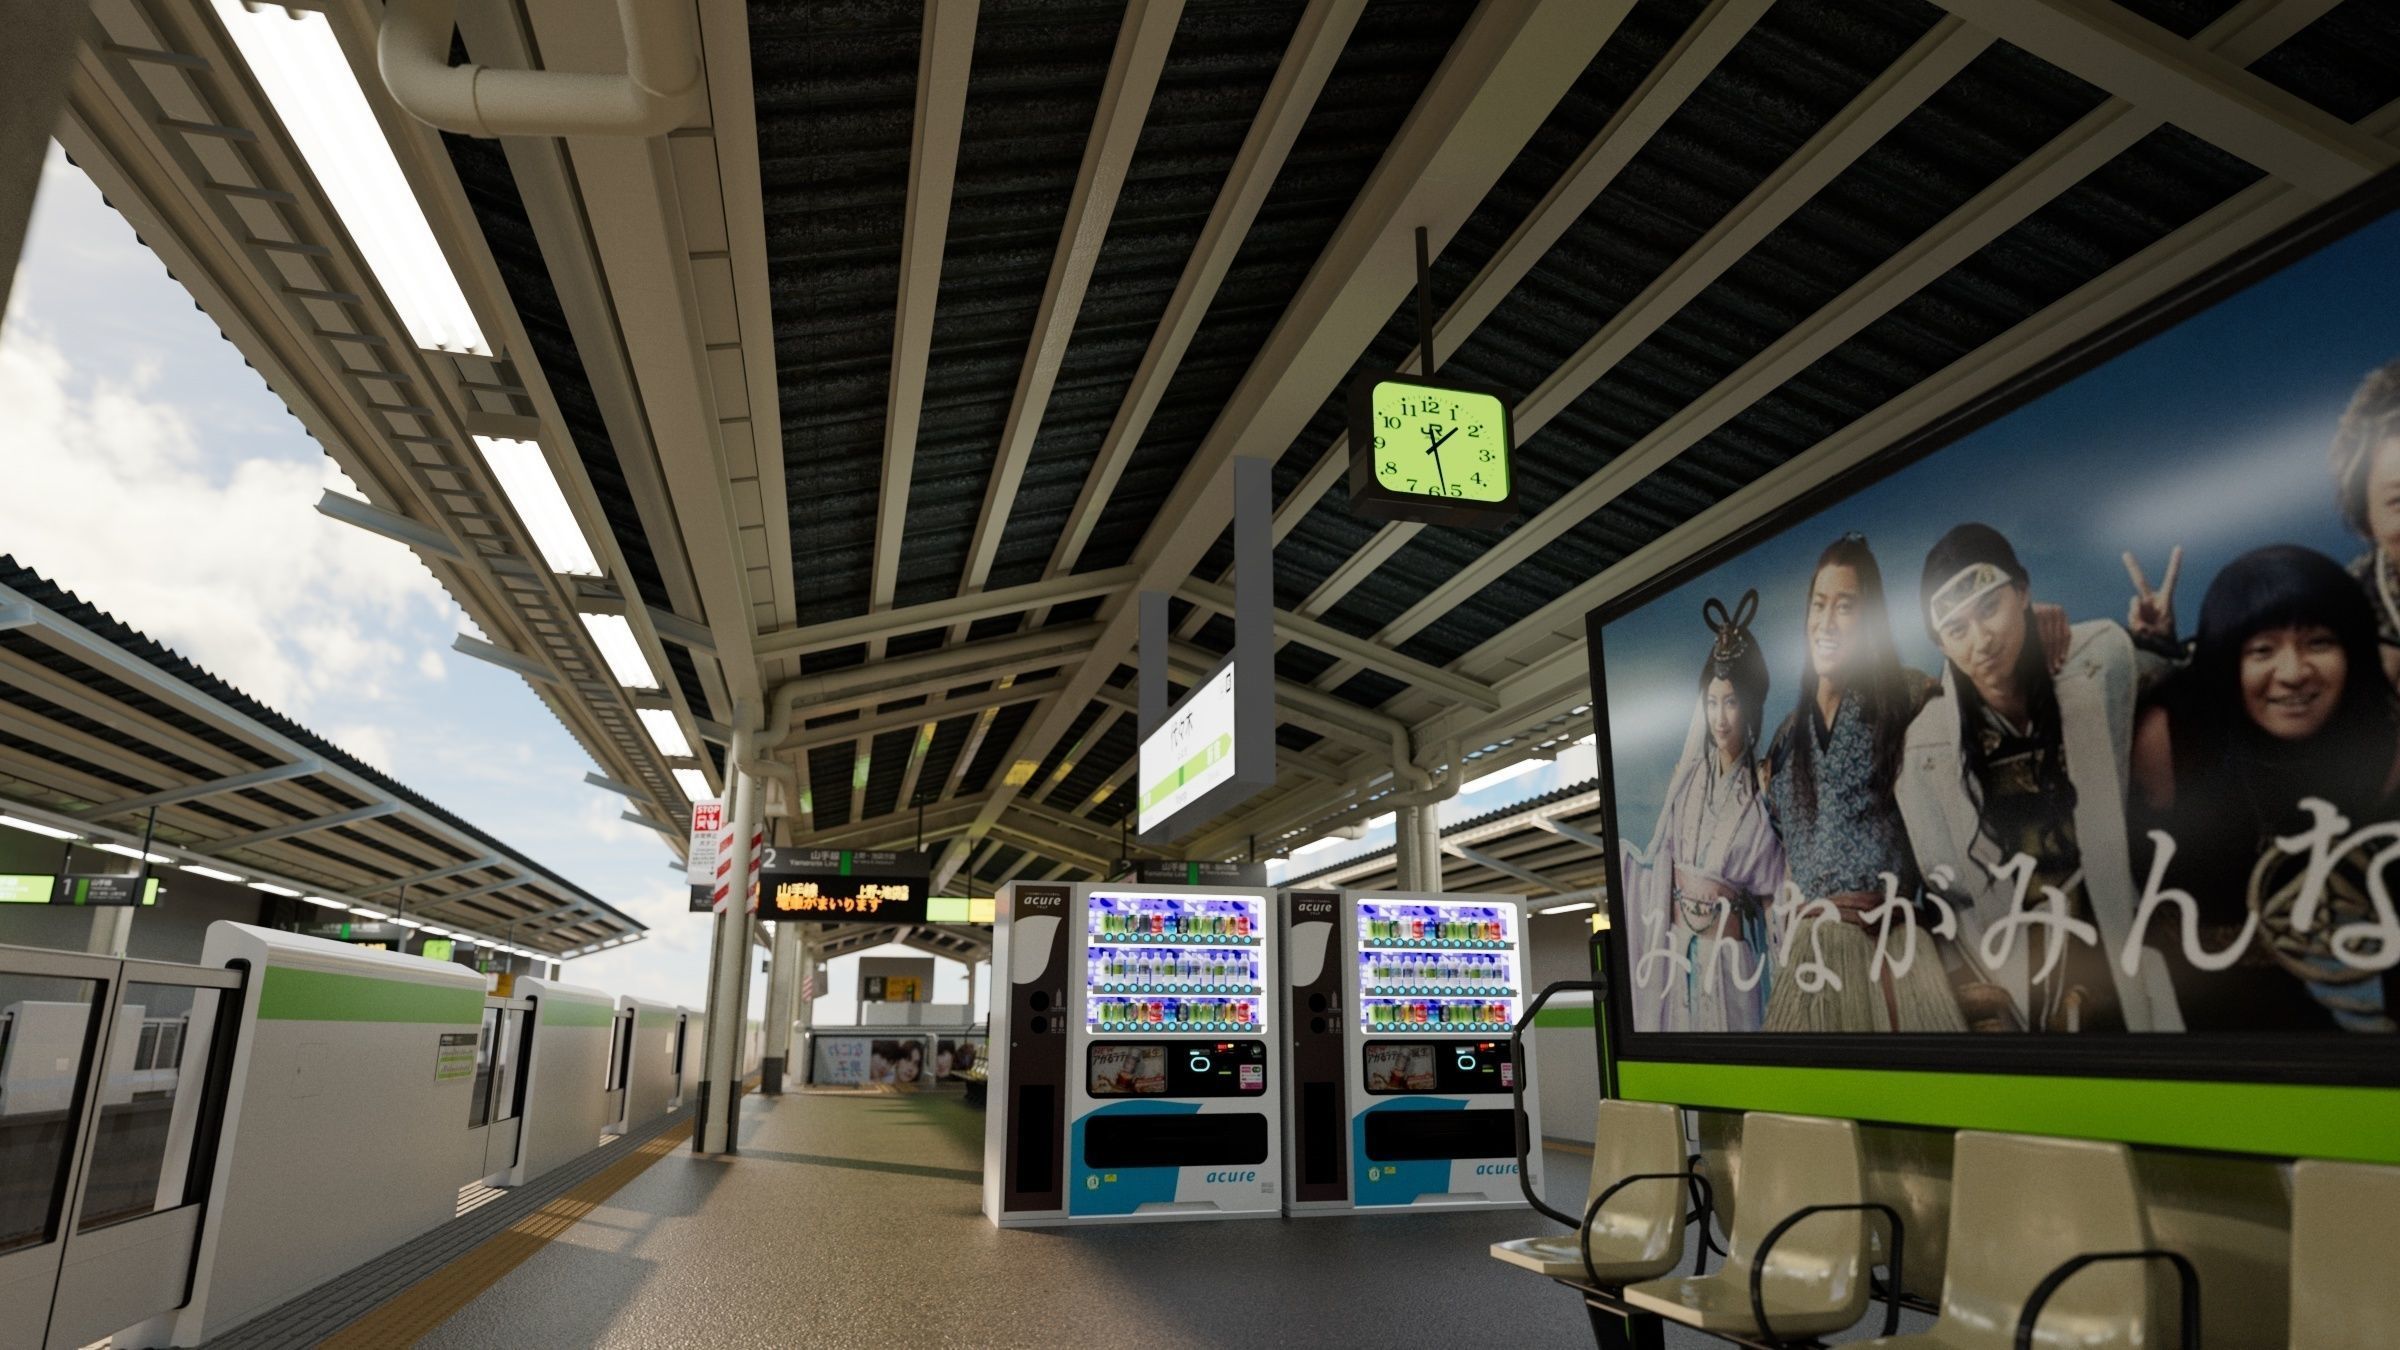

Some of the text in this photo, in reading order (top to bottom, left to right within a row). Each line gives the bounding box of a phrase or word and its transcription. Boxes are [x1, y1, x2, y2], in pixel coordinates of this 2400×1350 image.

[1401, 403, 1417, 417] 11
[1421, 400, 1440, 414] 12
[1449, 408, 1457, 421] 1
[1383, 416, 1402, 430] 10
[1420, 423, 1443, 437] JR
[1467, 424, 1480, 438] 2
[1374, 436, 1386, 449] 9
[1479, 449, 1491, 463] 3
[1385, 461, 1398, 475] 8
[1406, 478, 1418, 492] 7
[1470, 471, 1483, 485] 4
[1428, 486, 1441, 497] 6
[1450, 484, 1463, 497] 5
[696, 805, 720, 815] STOP
[762, 848, 777, 868] 2
[62, 878, 72, 896] 1
[1024, 896, 1061, 906] acure
[1636, 796, 2400, 999] みんながみんな
[1298, 903, 1332, 912] acure
[1476, 1164, 1519, 1175] acure
[1206, 1171, 1256, 1183] acure
